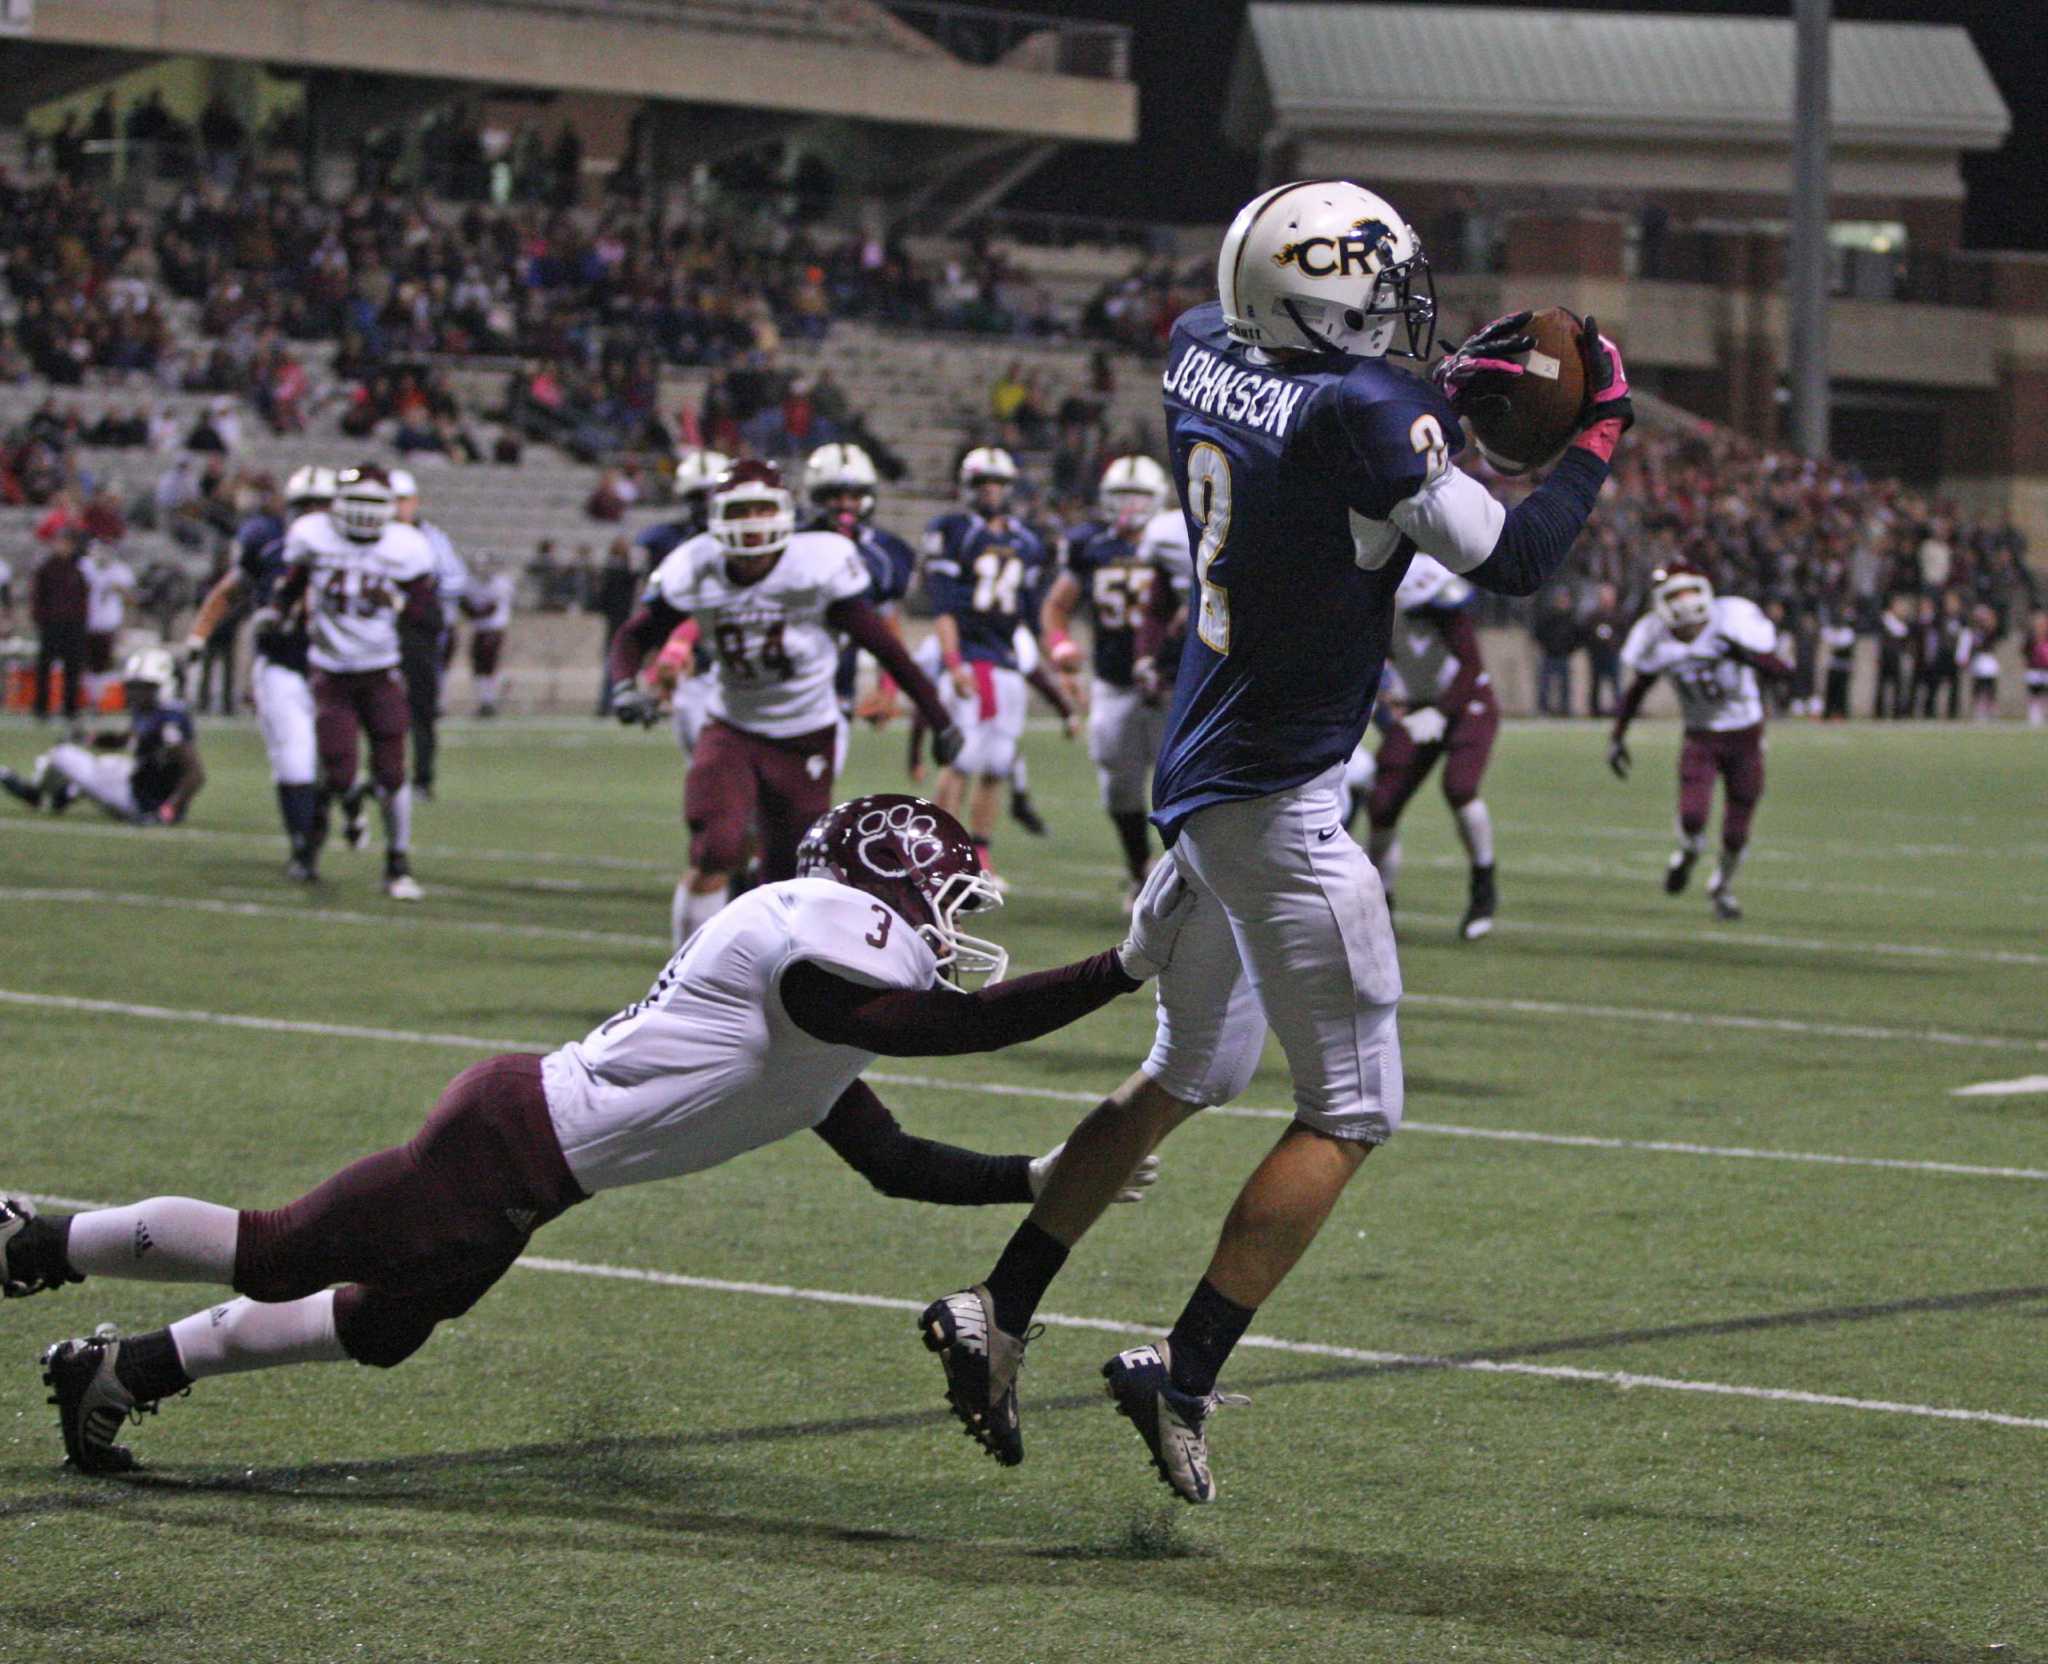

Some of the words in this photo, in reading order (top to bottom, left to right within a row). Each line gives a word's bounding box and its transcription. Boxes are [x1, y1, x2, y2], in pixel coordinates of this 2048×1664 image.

[1162, 344, 1304, 438] JOHNSON
[1408, 411, 1449, 482] 2
[1187, 440, 1233, 657] 2
[865, 903, 893, 950] 3
